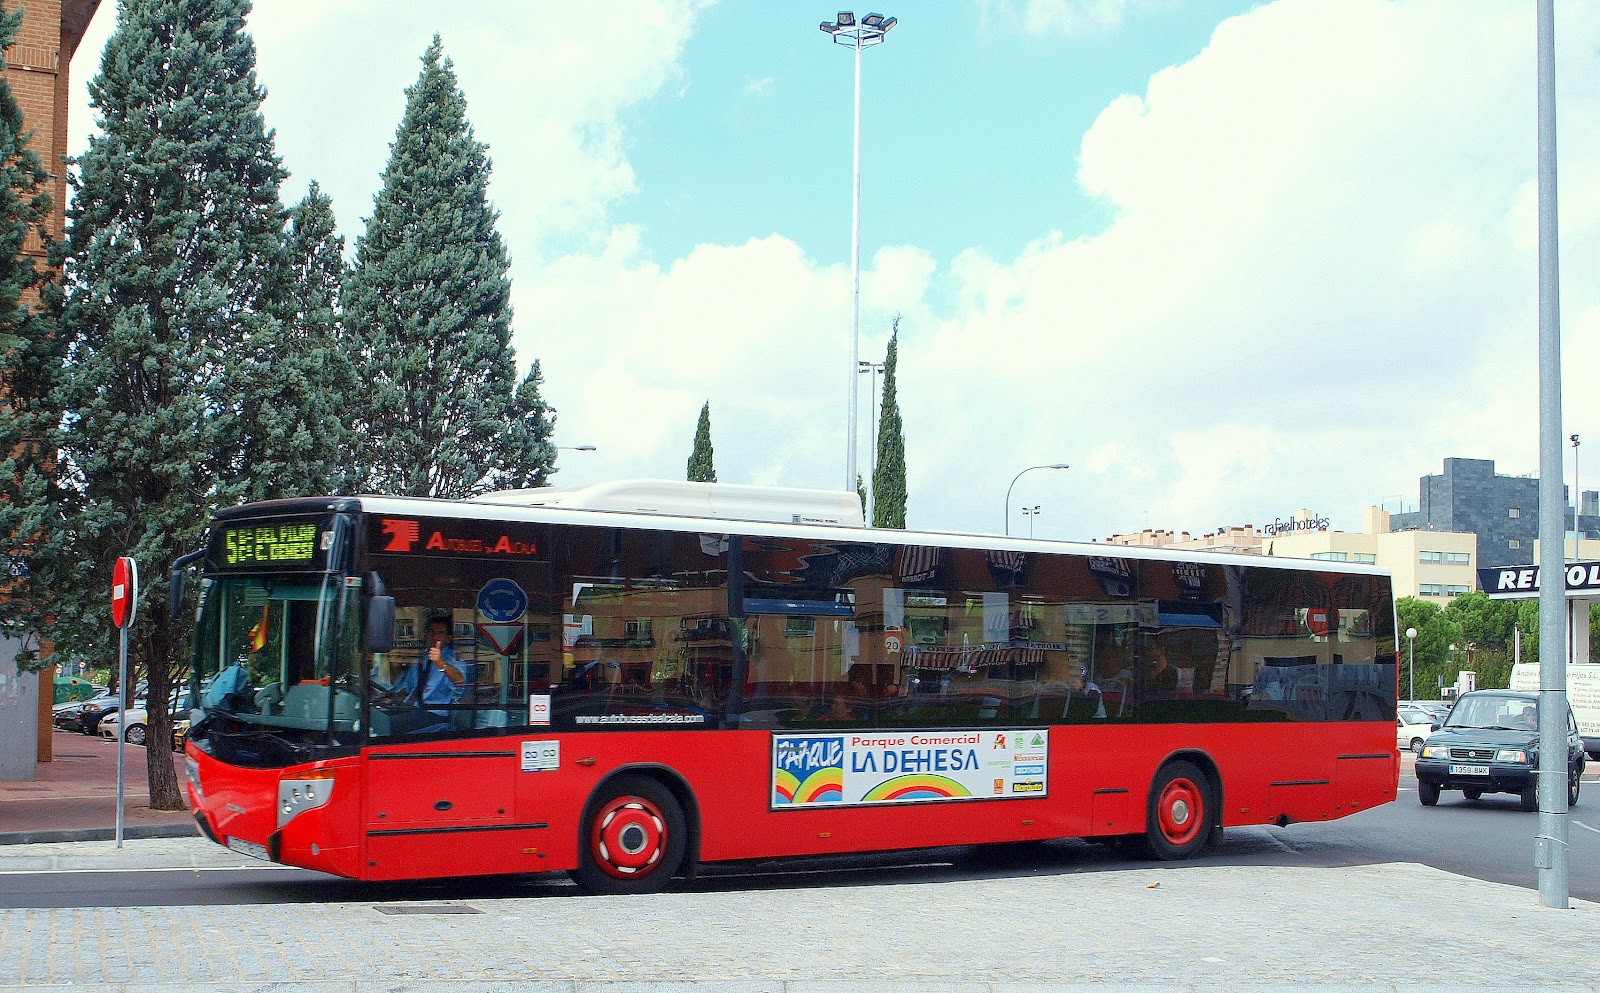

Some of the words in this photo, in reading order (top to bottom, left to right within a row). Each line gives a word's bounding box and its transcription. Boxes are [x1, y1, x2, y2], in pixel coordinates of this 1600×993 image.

[1264, 512, 1330, 534] rafaelhoteles
[226, 529, 238, 564] 5
[1498, 565, 1600, 590] REOL
[886, 641, 899, 650] 20
[852, 736, 906, 748] Parque
[911, 734, 980, 745] Comercial
[777, 740, 843, 771] PARQUE
[852, 751, 878, 773] LA
[883, 748, 979, 773] DEHESA
